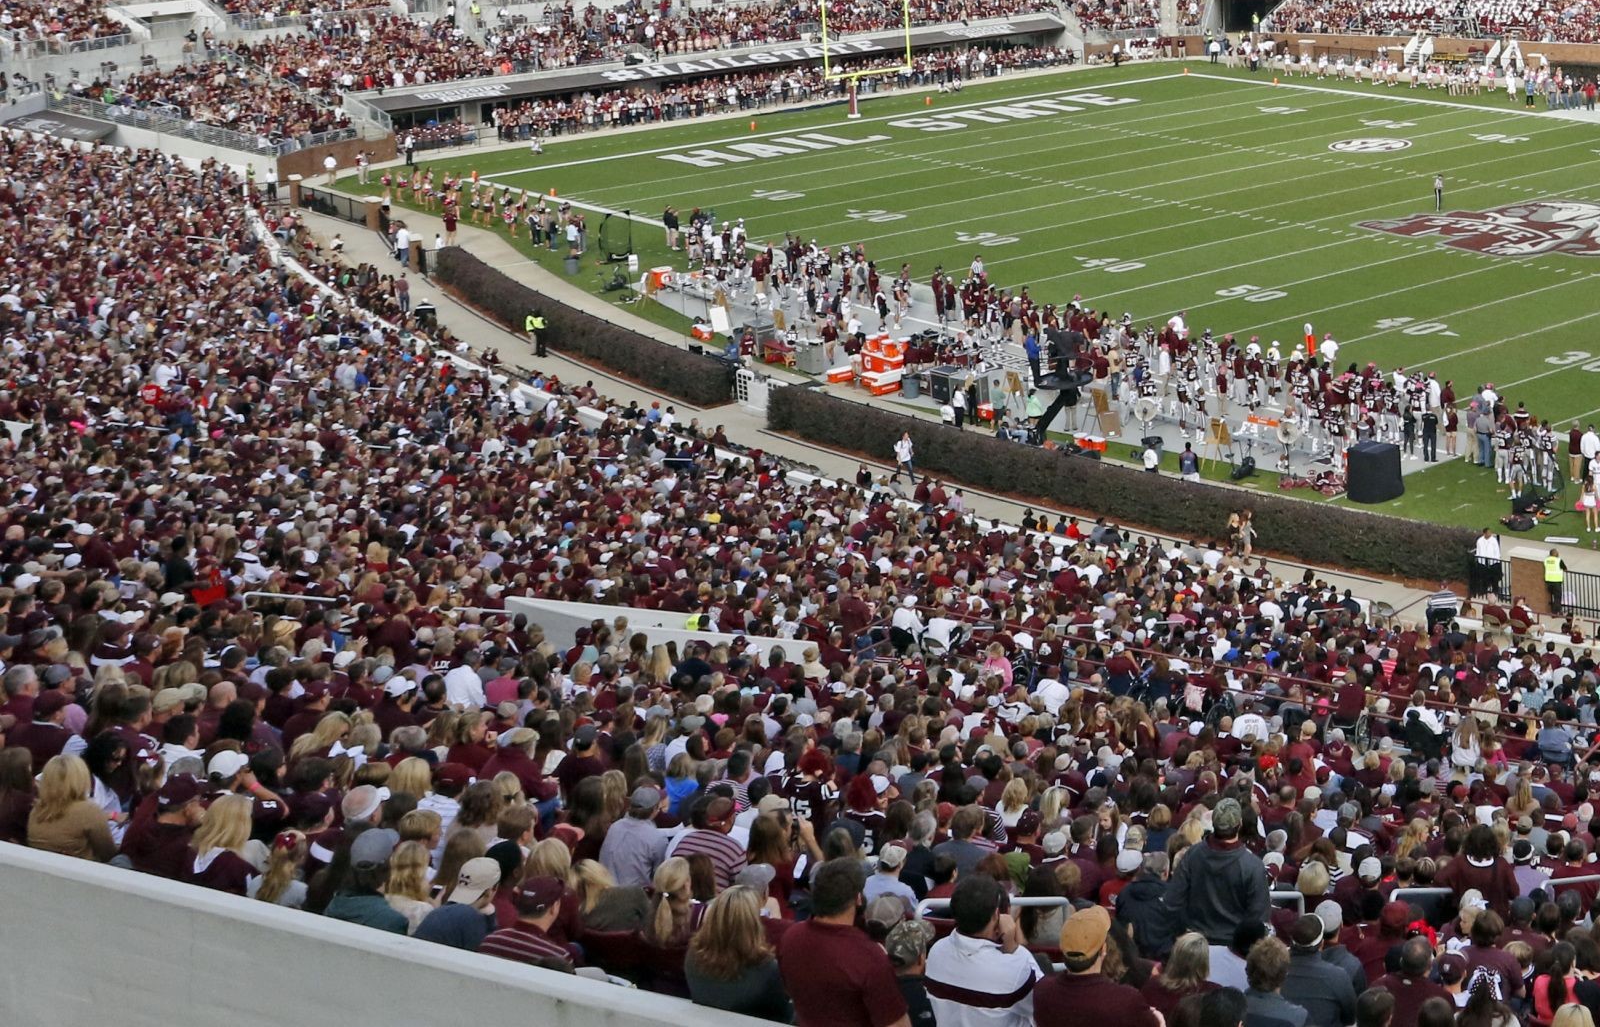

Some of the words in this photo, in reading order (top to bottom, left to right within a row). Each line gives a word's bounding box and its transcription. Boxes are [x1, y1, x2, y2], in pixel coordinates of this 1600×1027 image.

[600, 39, 883, 82] #HAILSTATE
[656, 132, 893, 168] HAIL
[888, 92, 1141, 132] STATE
[1424, 218, 1536, 242] STATE
[1215, 284, 1288, 303] 50
[1374, 316, 1449, 335] 40
[787, 333, 797, 341] 35
[864, 356, 872, 369] G
[1143, 385, 1154, 393] 14
[789, 795, 812, 819] 15
